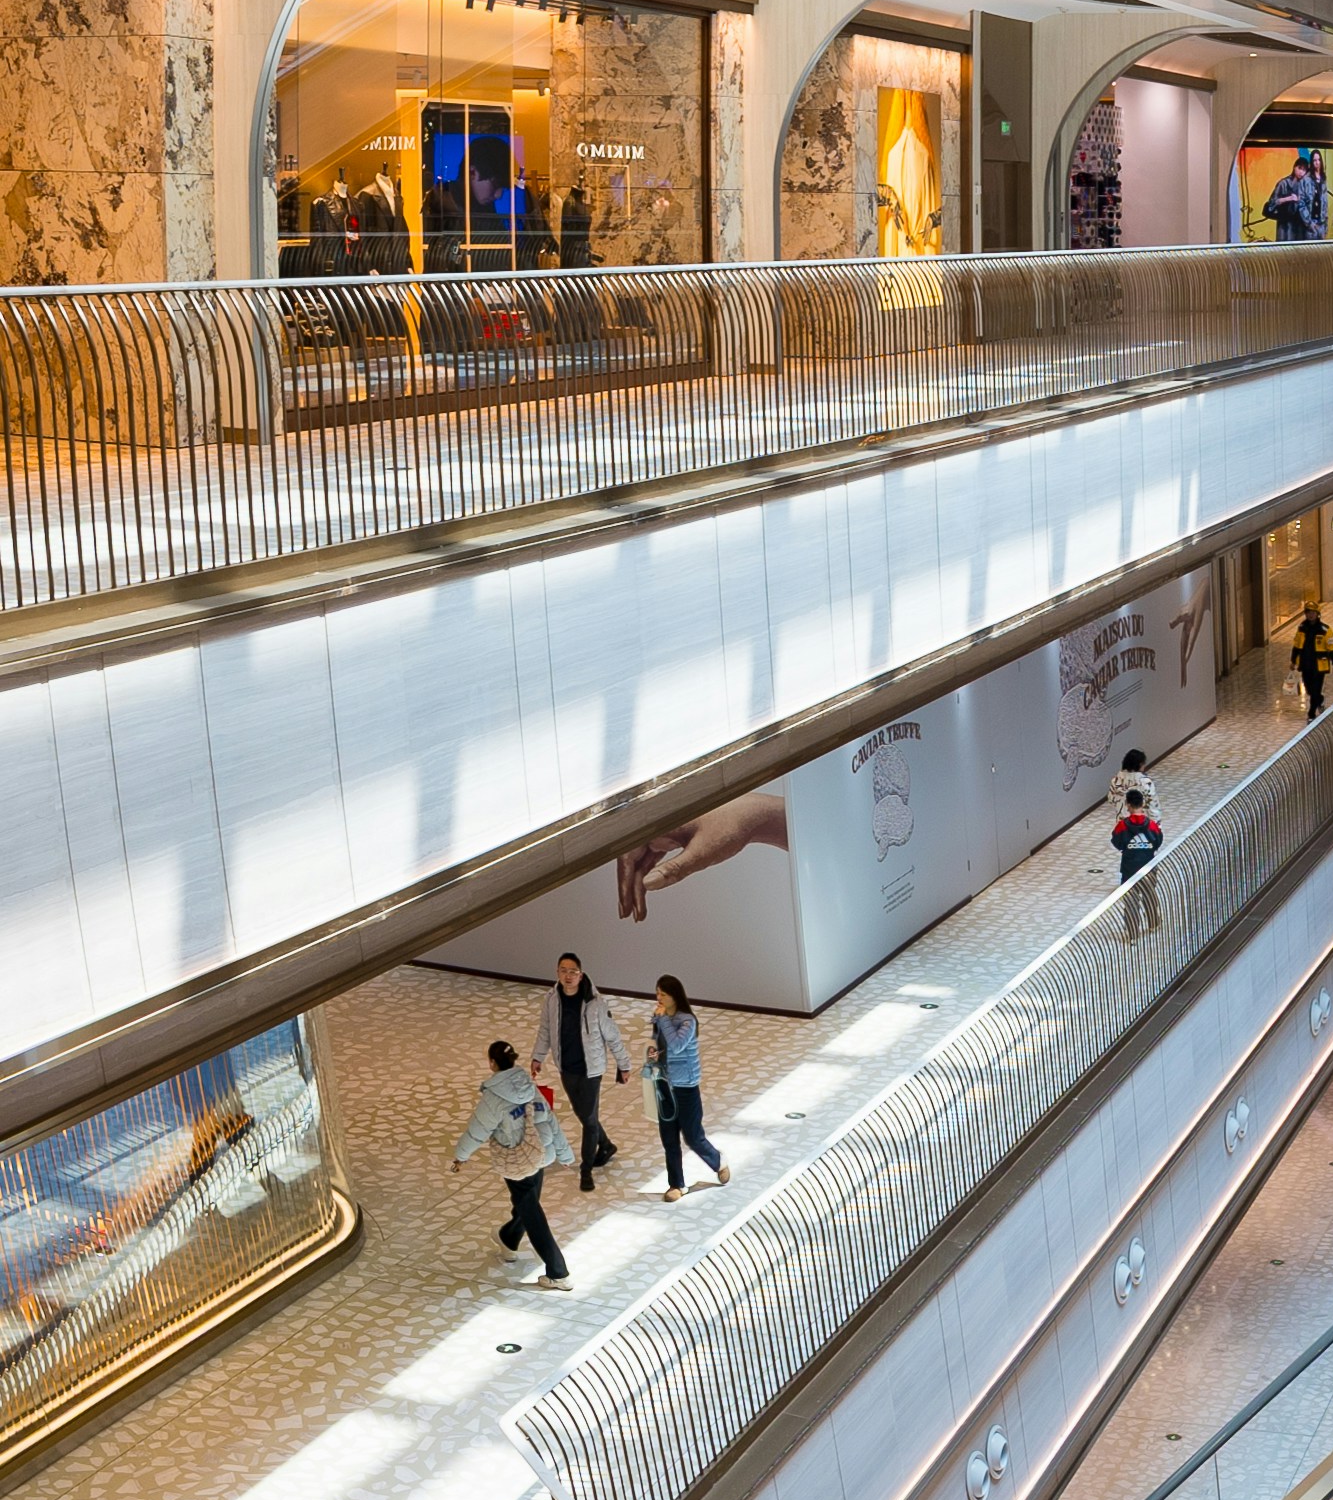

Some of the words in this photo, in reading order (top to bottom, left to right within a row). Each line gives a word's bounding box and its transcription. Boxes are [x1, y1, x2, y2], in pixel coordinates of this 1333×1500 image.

[1093, 616, 1131, 663] MAISON
[1132, 614, 1144, 636] DU
[1083, 655, 1119, 710] CAVIAR
[852, 729, 886, 774] CAVIAR
